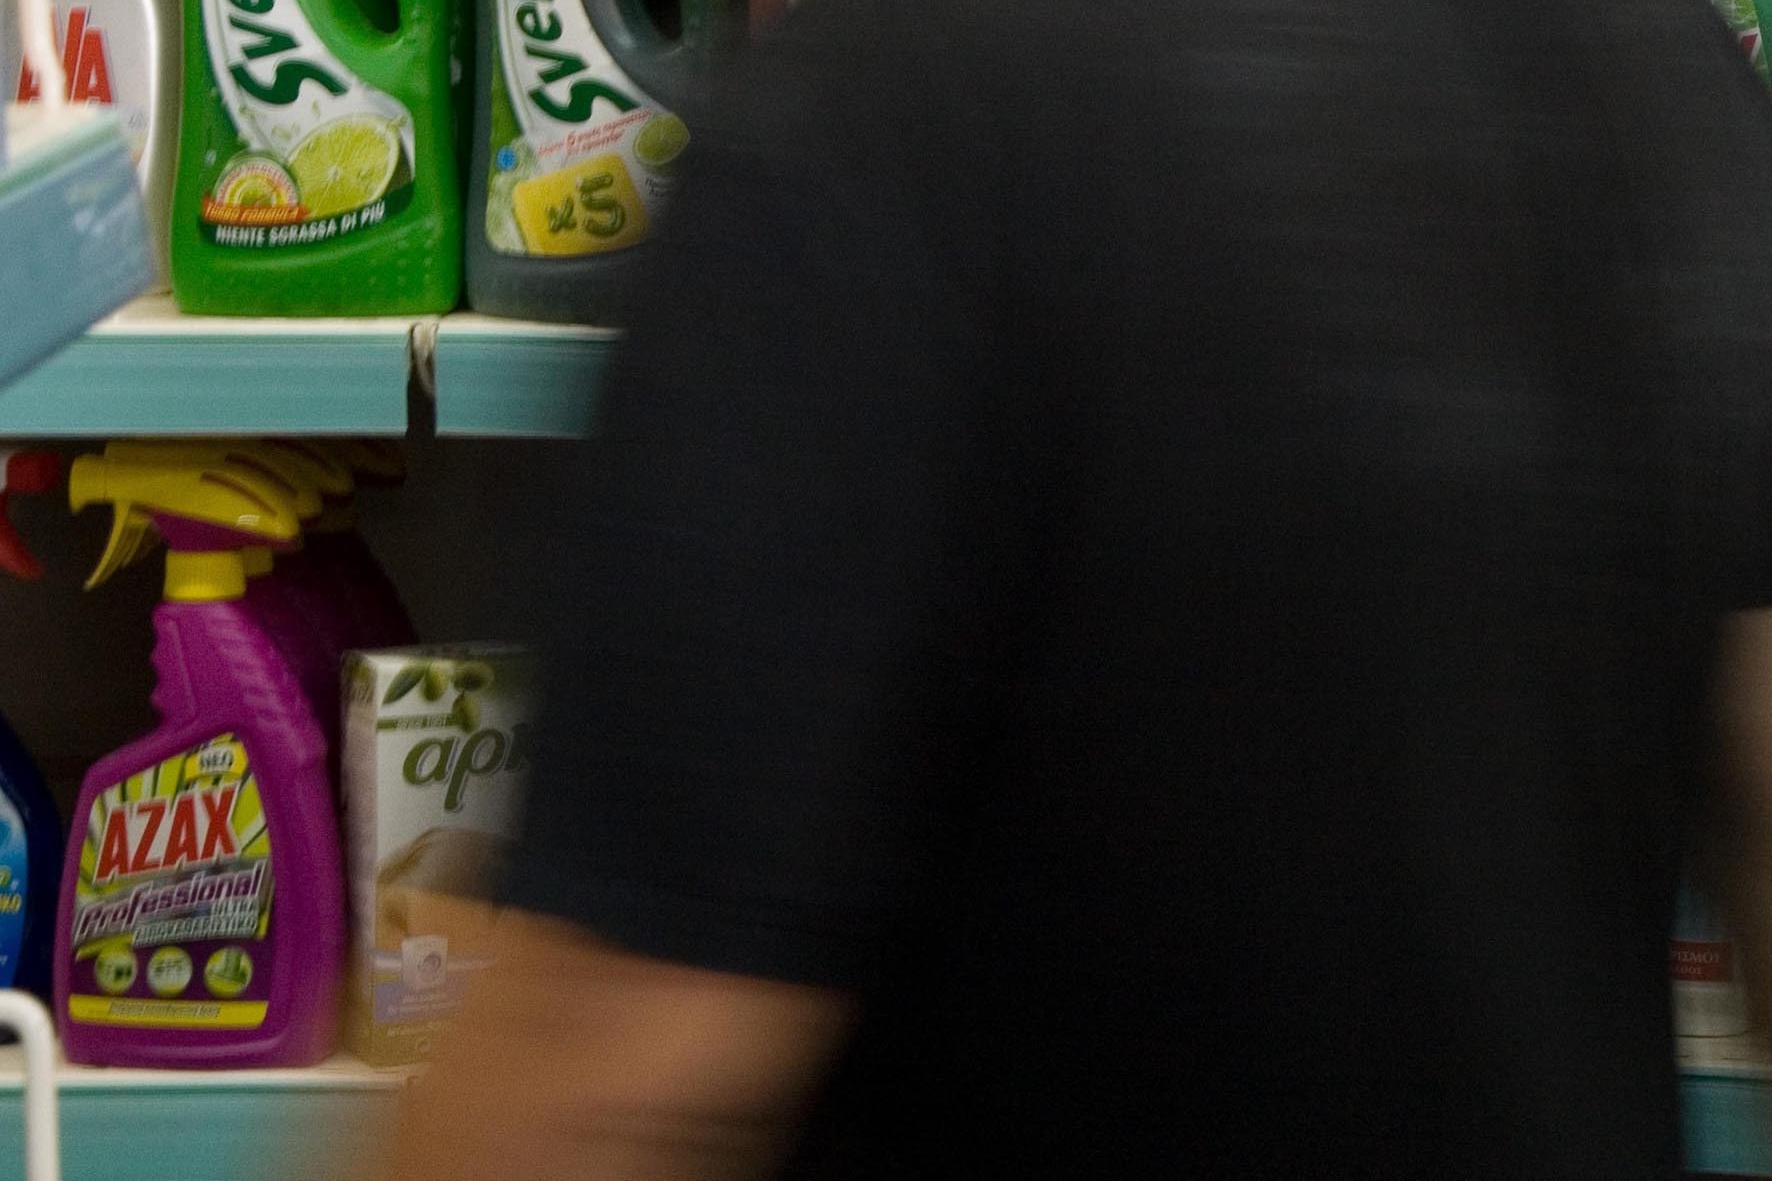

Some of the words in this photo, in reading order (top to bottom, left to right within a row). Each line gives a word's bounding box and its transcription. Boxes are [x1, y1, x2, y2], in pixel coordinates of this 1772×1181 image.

[215, 224, 266, 248] NIENTE
[96, 786, 238, 880] AZAX
[74, 861, 264, 948] Professional
